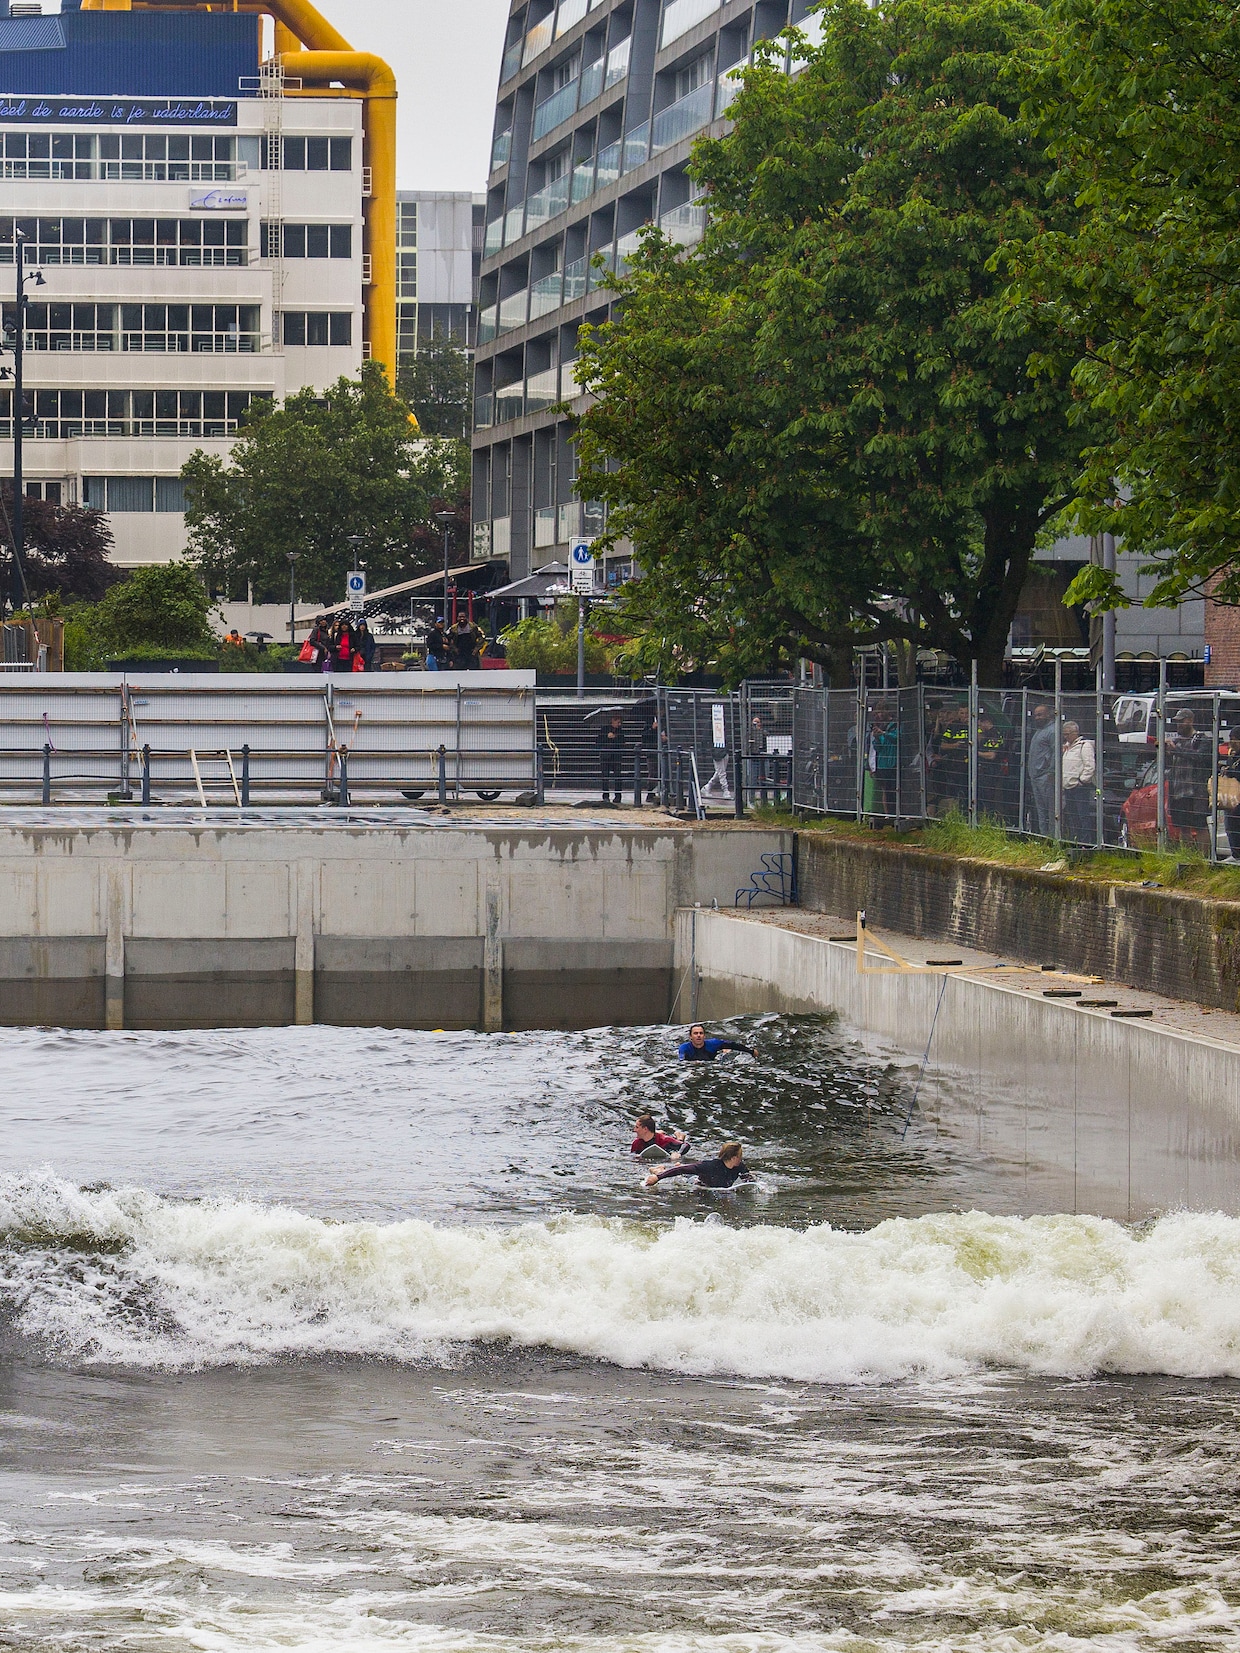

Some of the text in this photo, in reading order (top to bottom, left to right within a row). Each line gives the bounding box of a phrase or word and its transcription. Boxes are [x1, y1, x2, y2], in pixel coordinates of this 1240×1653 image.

[32, 101, 53, 117] de
[60, 102, 104, 118] aarde
[111, 105, 124, 118] is
[126, 105, 146, 123] je
[153, 102, 232, 119] vaderland
